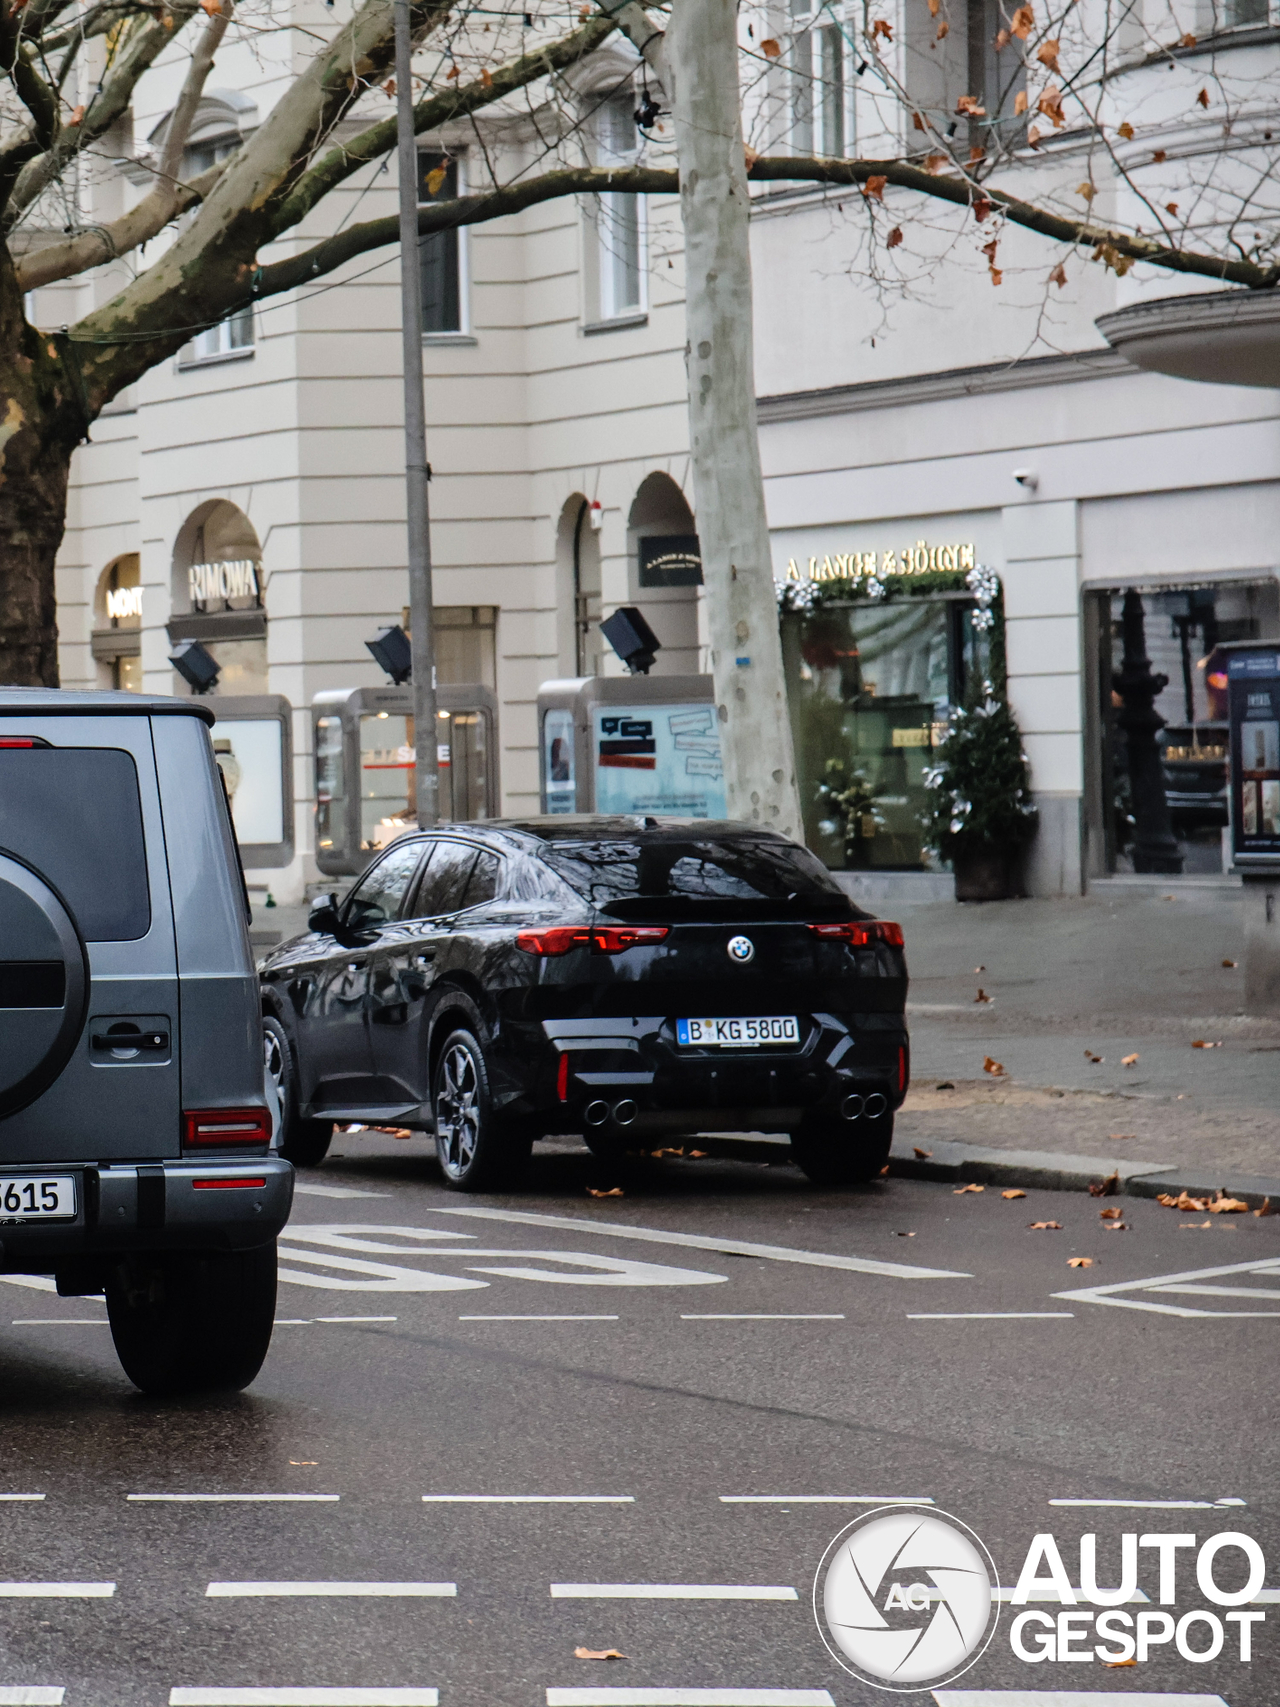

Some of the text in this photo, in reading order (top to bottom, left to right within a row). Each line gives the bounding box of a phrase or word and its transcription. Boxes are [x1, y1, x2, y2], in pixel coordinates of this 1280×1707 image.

[189, 560, 258, 601] RIMOWA
[690, 1019, 795, 1040] B KG 5800
